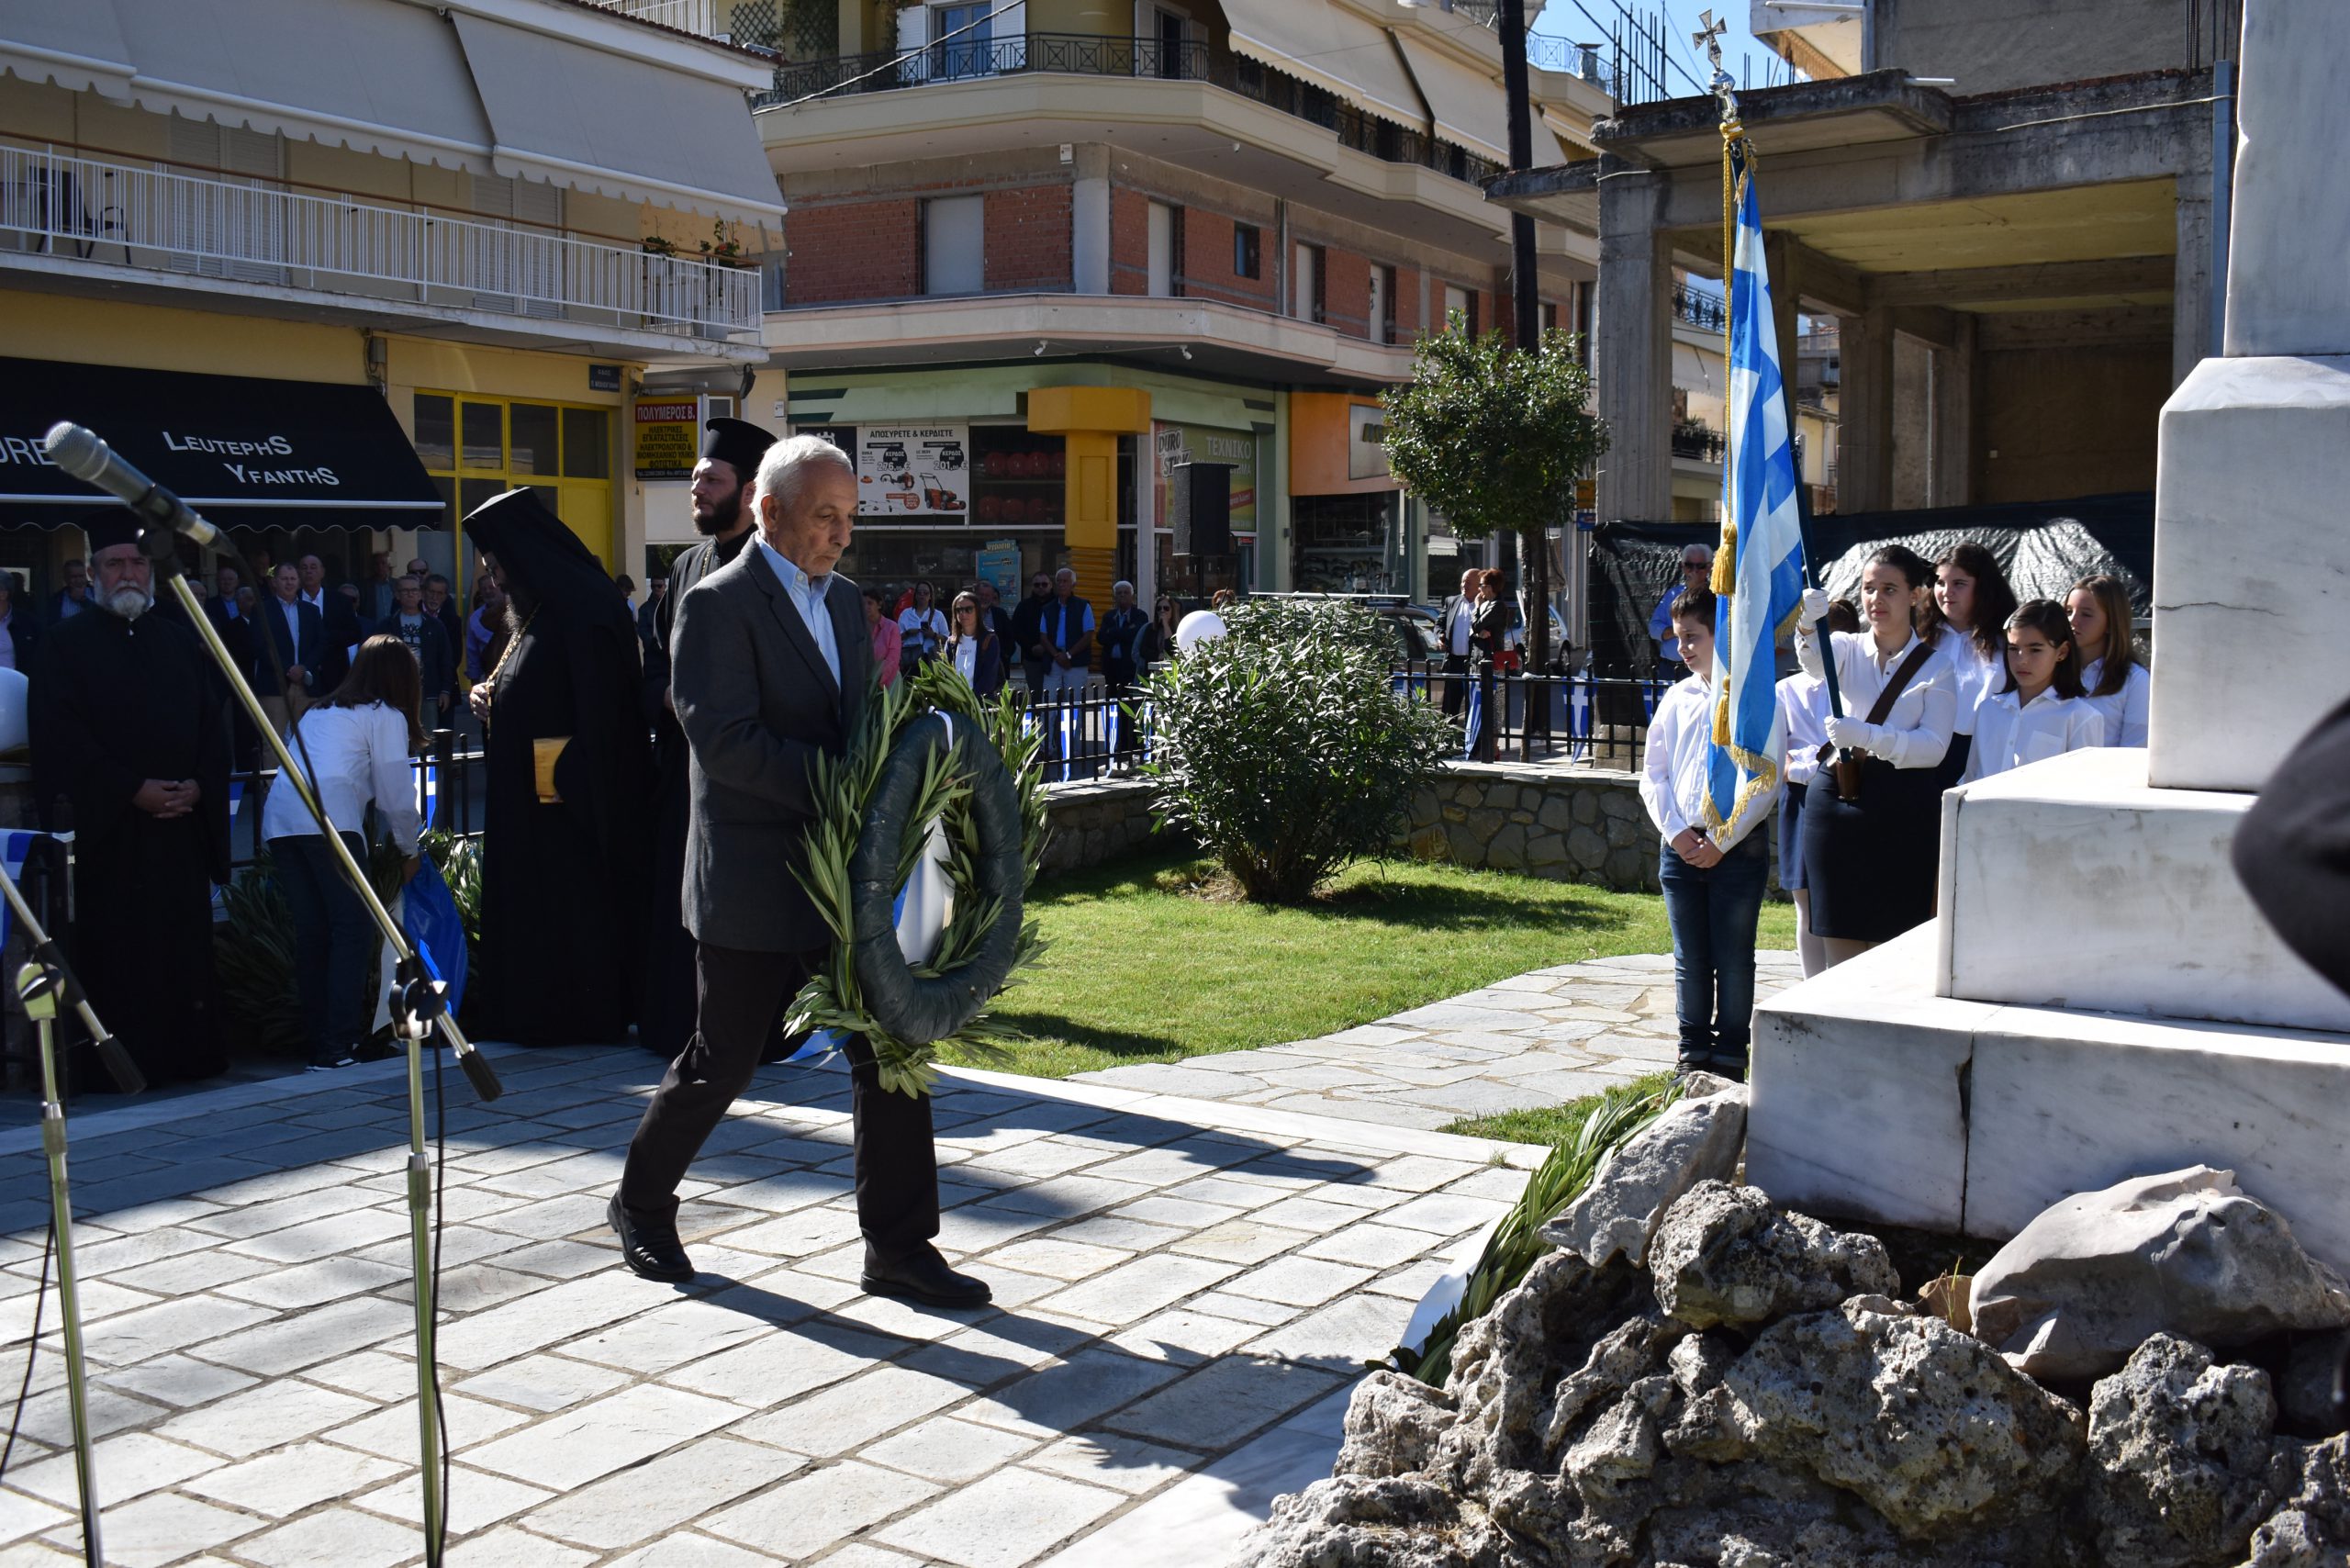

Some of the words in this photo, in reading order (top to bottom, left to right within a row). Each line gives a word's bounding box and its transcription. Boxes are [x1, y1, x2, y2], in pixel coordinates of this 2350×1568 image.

[637, 406, 687, 420] ΠΟΛΥΜΕΡΟΣ
[688, 406, 696, 420] Β.
[162, 431, 294, 456] LEUTEPHS
[870, 430, 911, 438] ΑΠΟΣΥΡΕΤΕ
[1158, 431, 1181, 453] DURO
[1205, 436, 1251, 459] ΤΕΧΝΙΚΟ
[224, 463, 340, 486] YFANTHS
